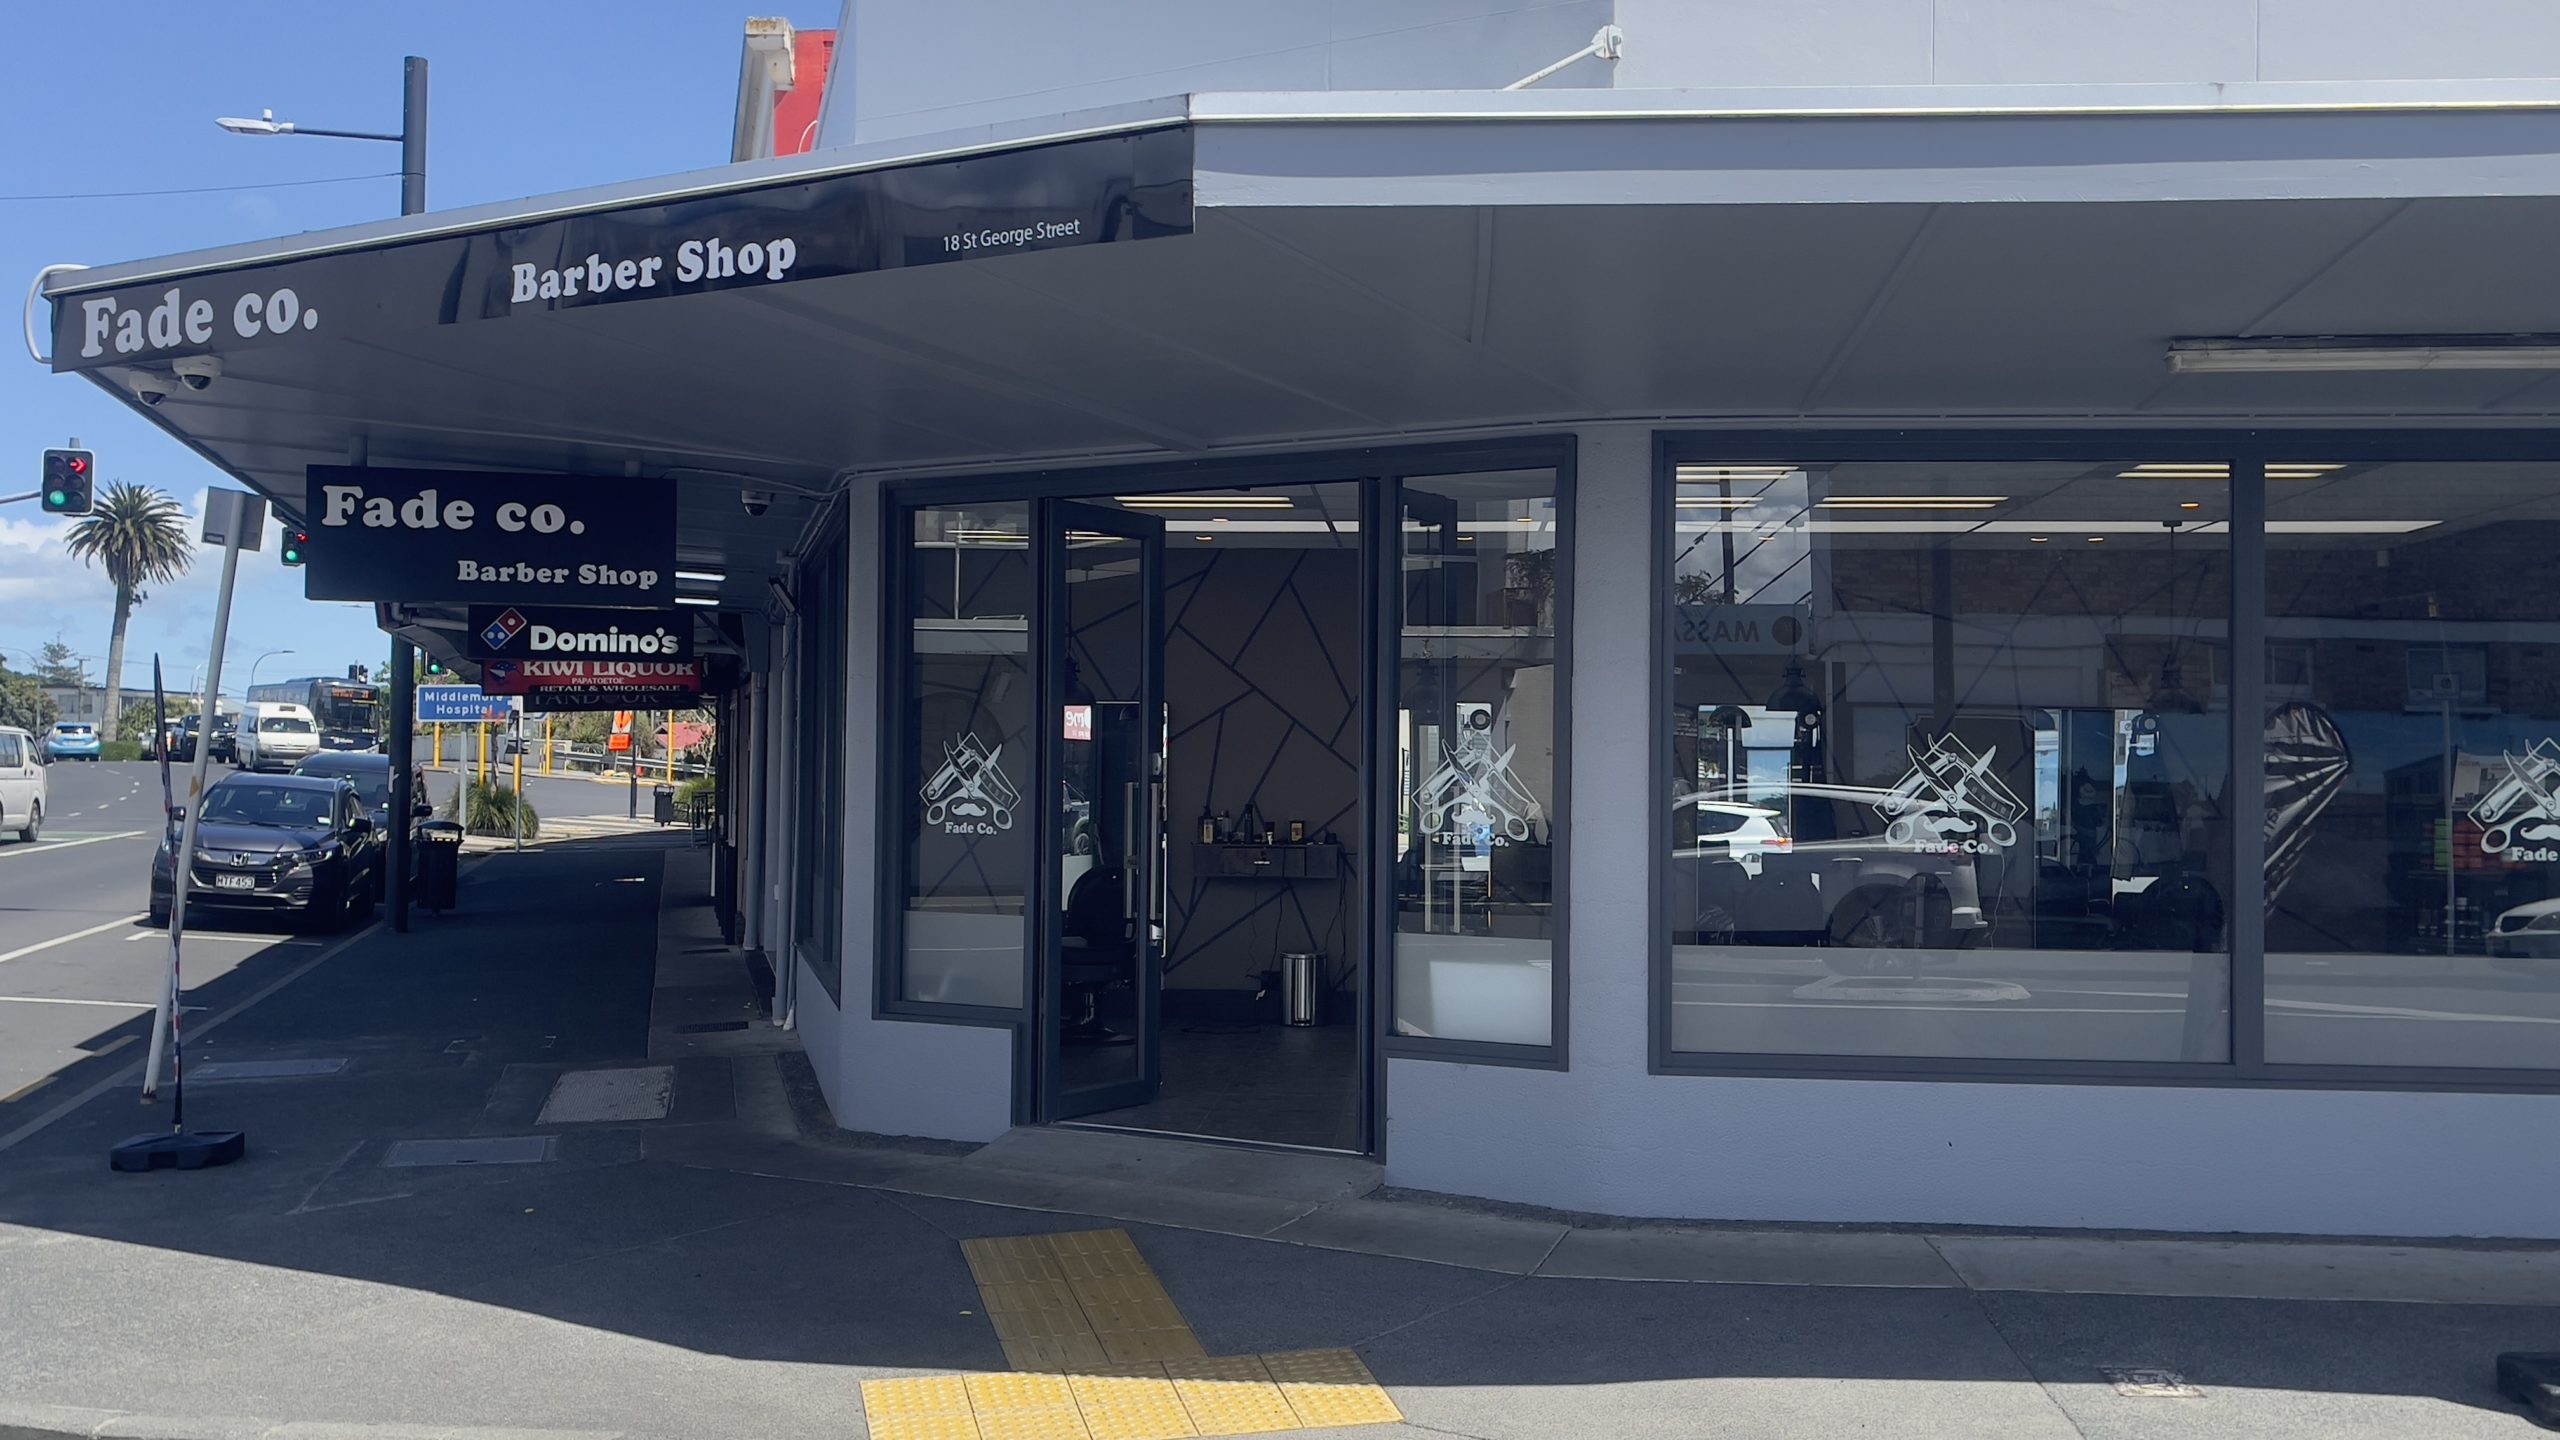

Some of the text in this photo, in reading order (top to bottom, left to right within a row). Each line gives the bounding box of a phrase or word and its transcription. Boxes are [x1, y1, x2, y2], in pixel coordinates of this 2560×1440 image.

[943, 218, 1081, 252] 18 St George Street
[511, 237, 797, 304] Barber Shop
[81, 287, 319, 358] Fade co.
[321, 484, 586, 536] Fade co.
[457, 560, 659, 590] Barber Shop
[530, 625, 680, 654] Domino's
[522, 660, 695, 678] KIWI LIQUOR
[571, 677, 625, 685] PAPATOETOE
[424, 691, 503, 702] Middlemore
[436, 704, 493, 716] Hospital
[945, 821, 998, 835] Fade Co.
[1485, 833, 1510, 847] Co.
[1914, 839, 1994, 854] Fade Co.
[2511, 846, 2559, 862] Fade
